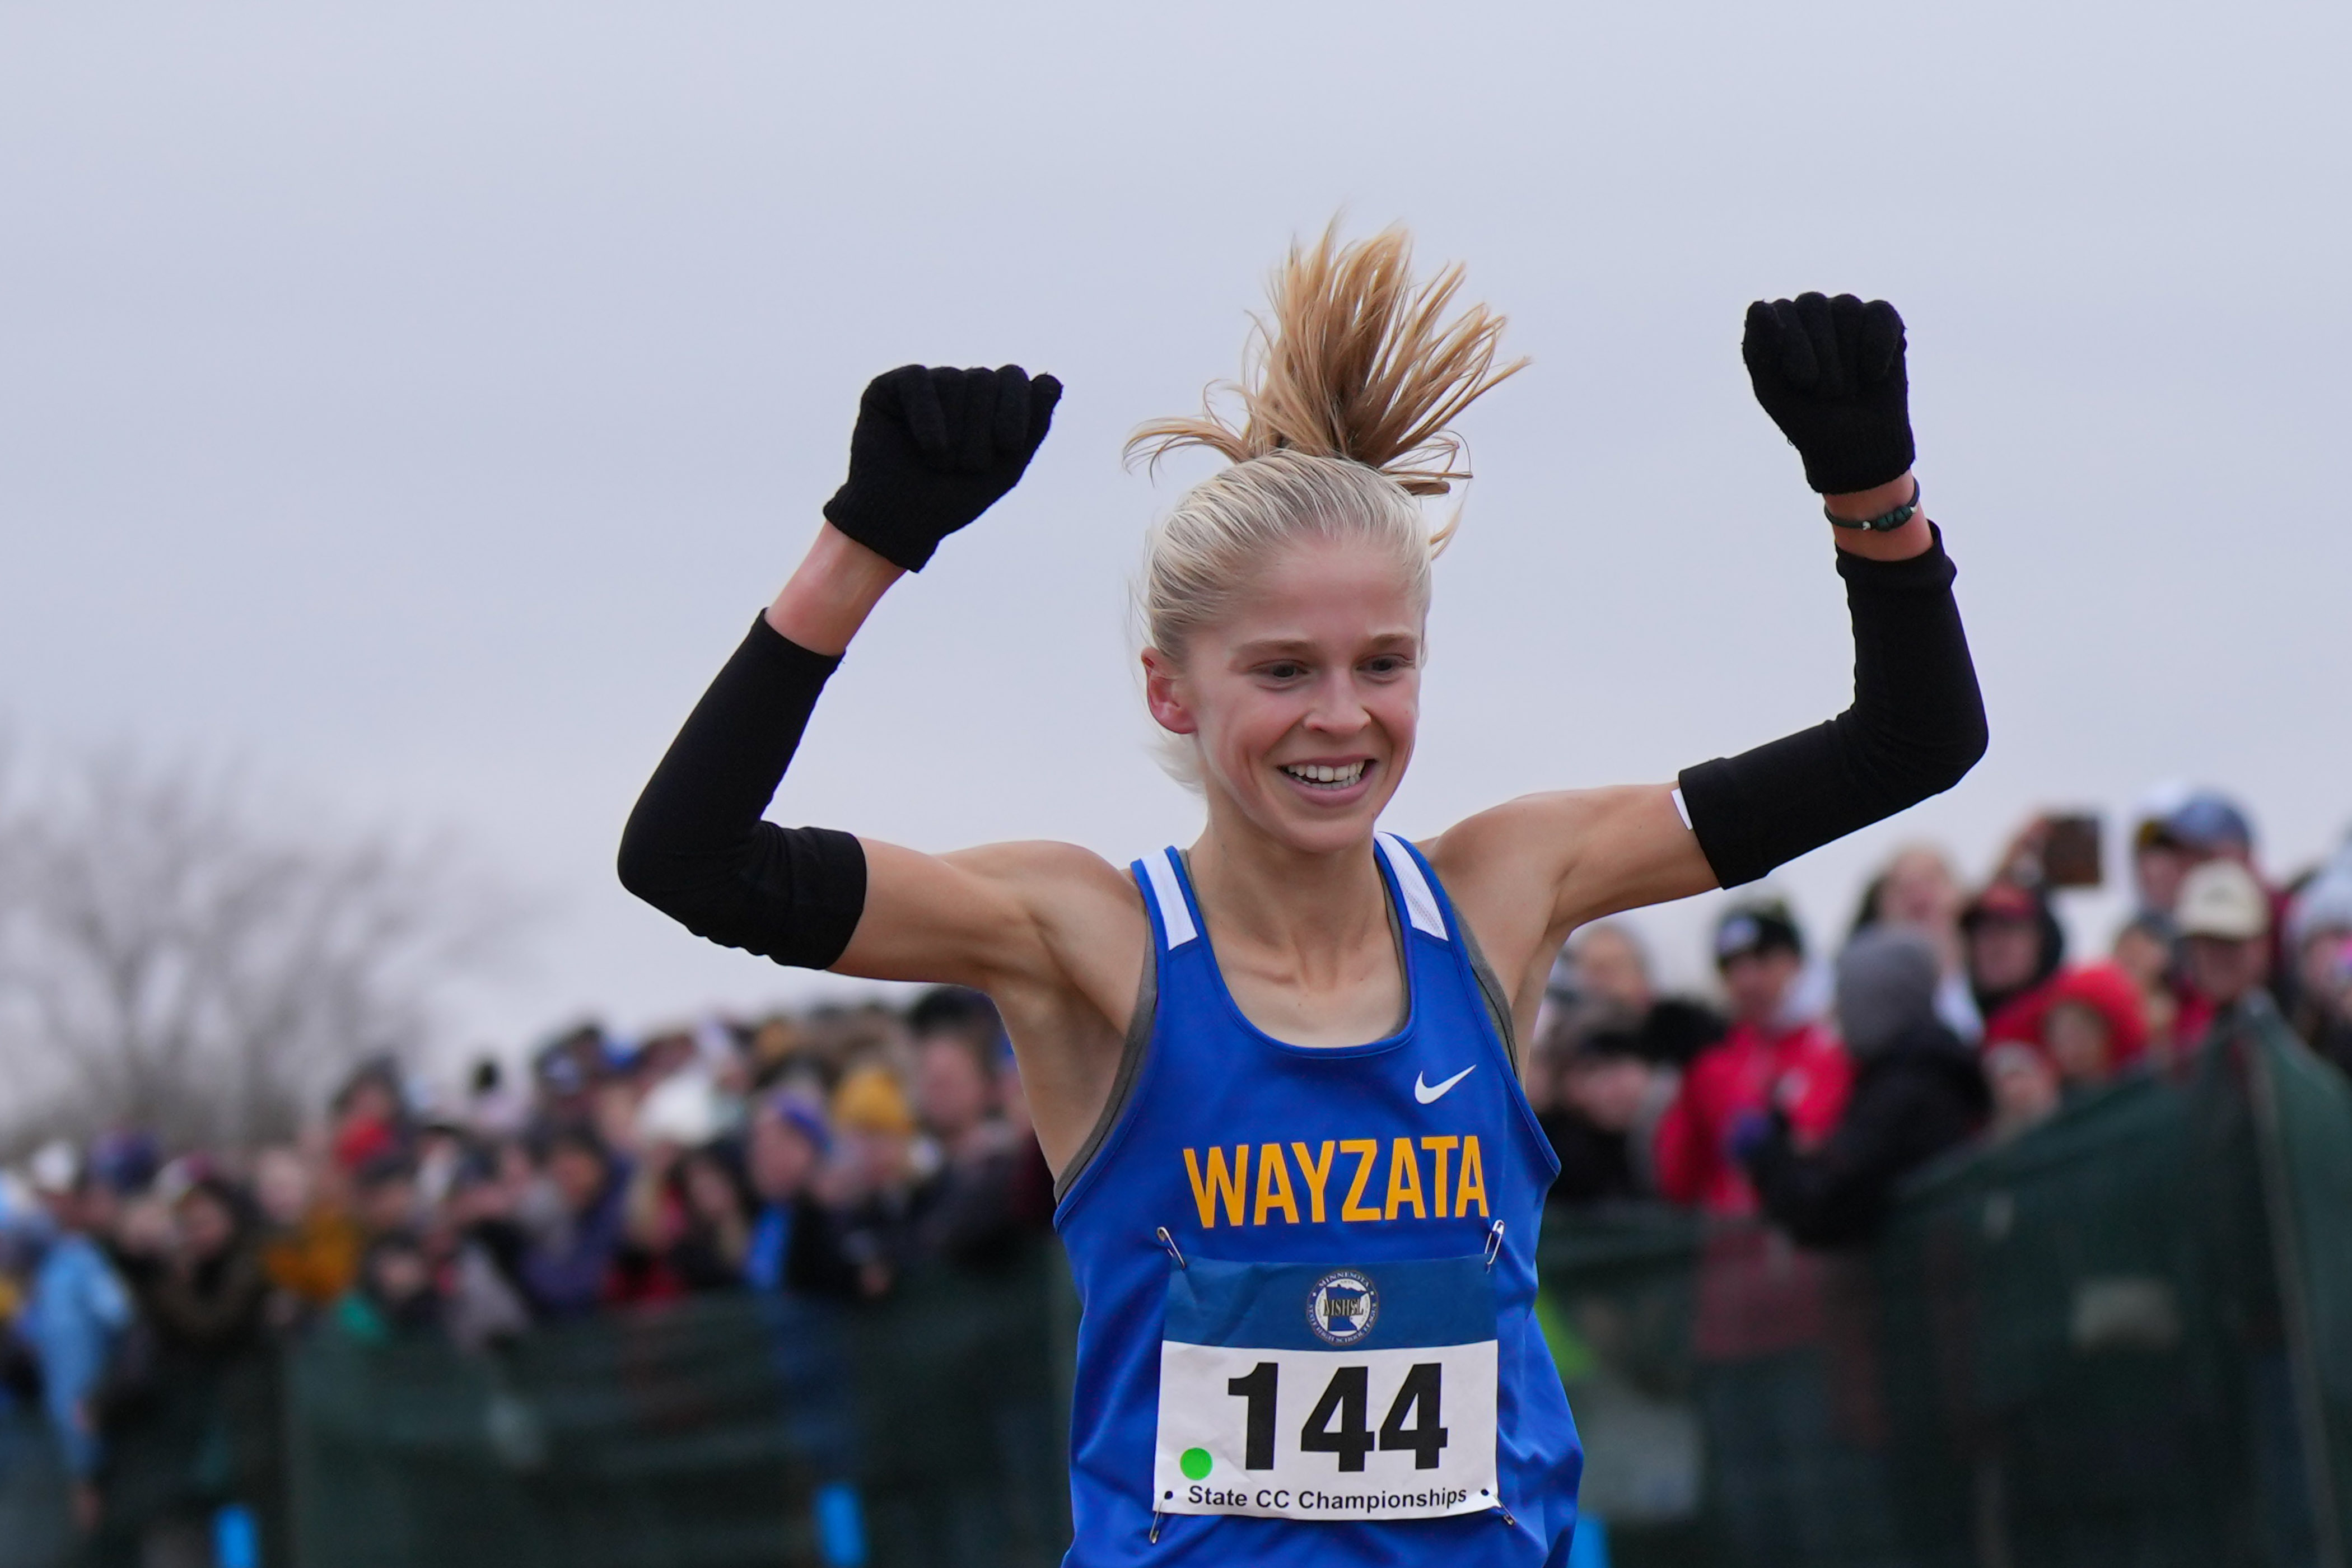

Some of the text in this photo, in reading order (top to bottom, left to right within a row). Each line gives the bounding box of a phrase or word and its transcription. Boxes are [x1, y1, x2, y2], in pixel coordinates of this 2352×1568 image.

[1183, 1135, 1489, 1228] WAYZATA
[1318, 1272, 1369, 1287] MINNESOTA
[1323, 1299, 1364, 1316] MSHSL
[1228, 1362, 1447, 1472] 144
[1188, 1485, 1467, 1513] State CC Championships
